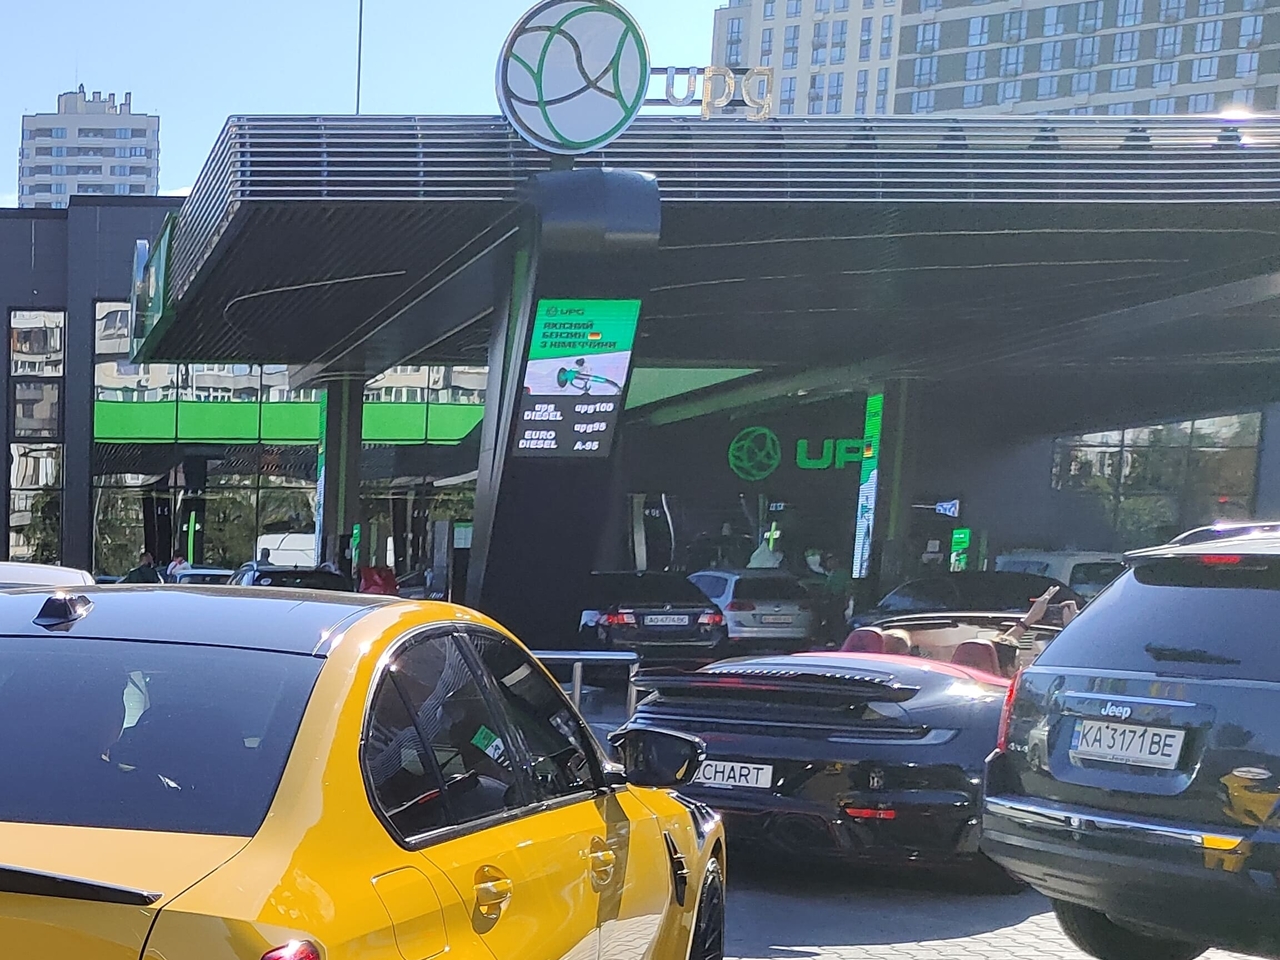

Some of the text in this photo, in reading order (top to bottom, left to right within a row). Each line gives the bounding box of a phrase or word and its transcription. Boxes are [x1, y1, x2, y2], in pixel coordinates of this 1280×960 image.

[665, 66, 774, 121] upg
[523, 411, 563, 421] DIESEL
[518, 439, 558, 449] DIESEL
[524, 430, 556, 439] EURO
[796, 438, 864, 469] UP
[1101, 701, 1133, 720] Jeep
[1079, 725, 1177, 758] KA 3171 BE
[696, 763, 765, 785] CHART
